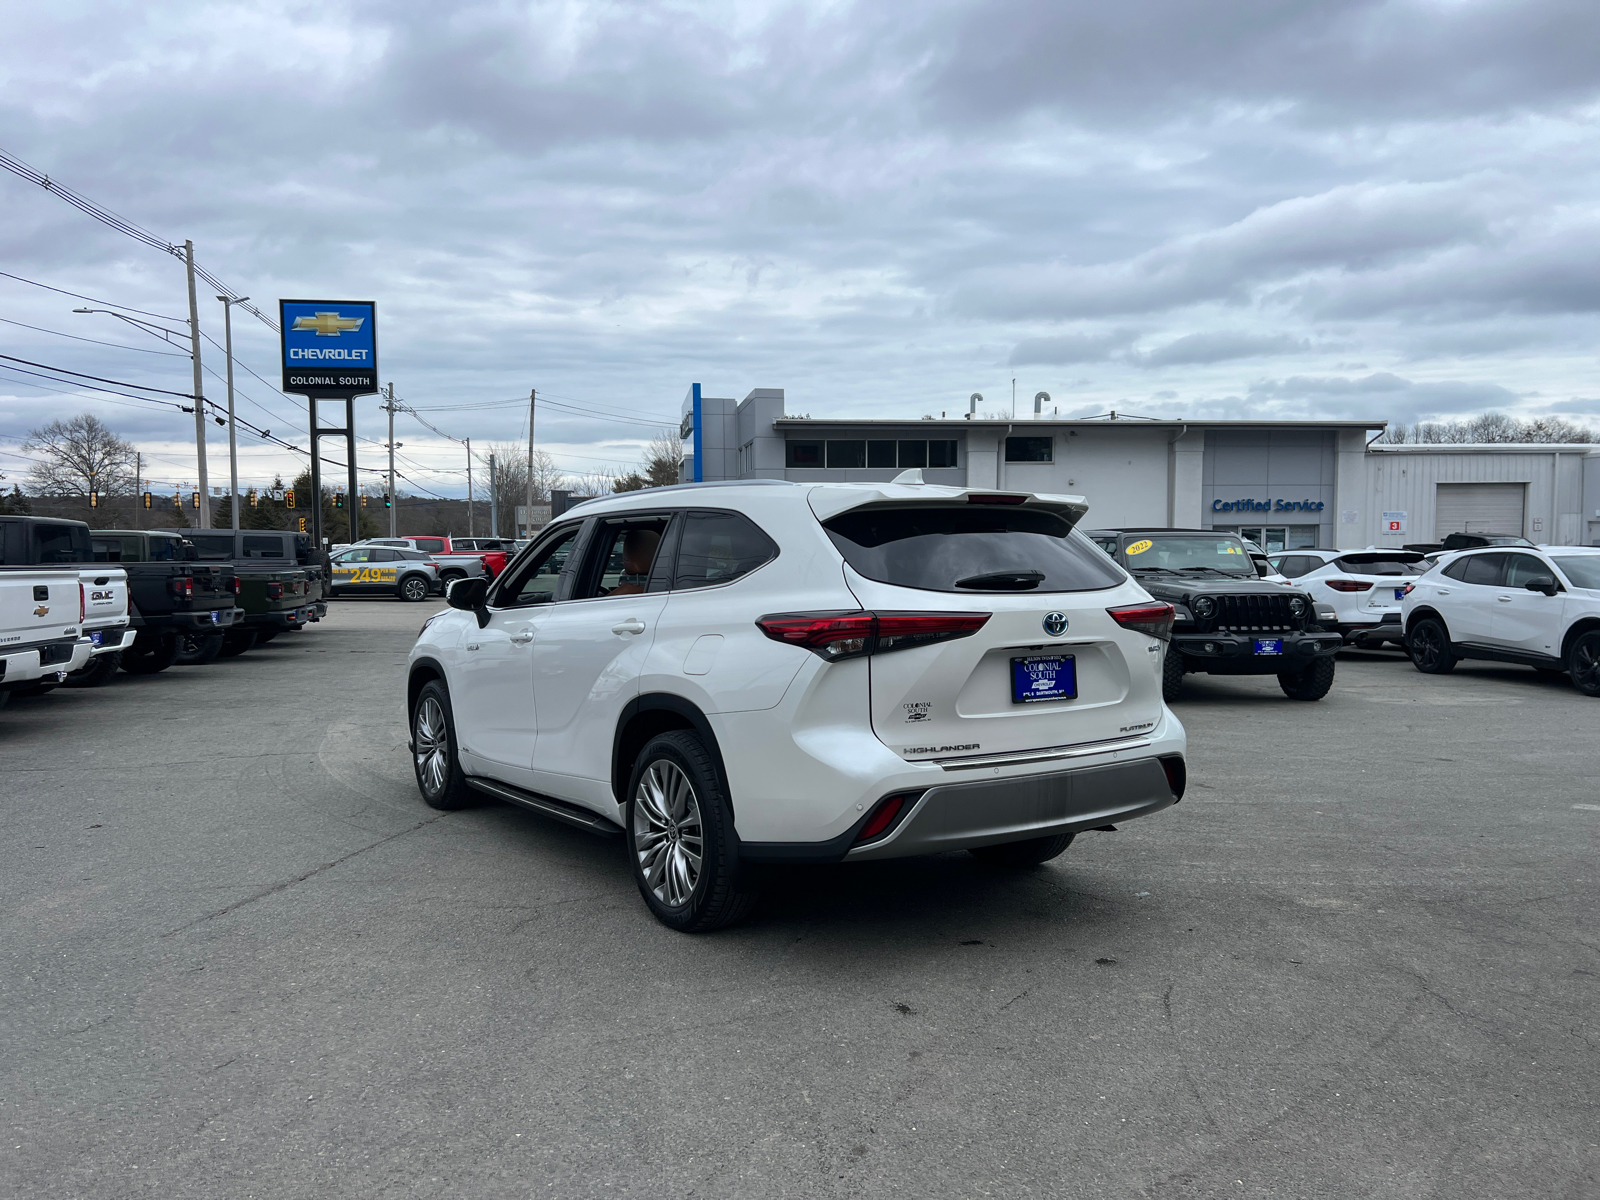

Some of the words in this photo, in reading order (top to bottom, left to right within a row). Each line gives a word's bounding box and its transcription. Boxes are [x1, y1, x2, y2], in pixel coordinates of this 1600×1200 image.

[290, 349, 368, 360] CHEVROLET
[290, 376, 336, 385] COLONIAL
[339, 377, 370, 385] SOUTH
[1213, 499, 1271, 511] Certified
[1275, 499, 1324, 511] Service
[1131, 541, 1149, 554] 2022
[91, 591, 114, 601] GMC
[1024, 662, 1061, 672] COLONIAL
[1030, 670, 1056, 680] SOUTH
[903, 702, 932, 710] COLONIAL
[1120, 722, 1153, 732] PLATINUM
[903, 743, 980, 754] HIGHLANDER
